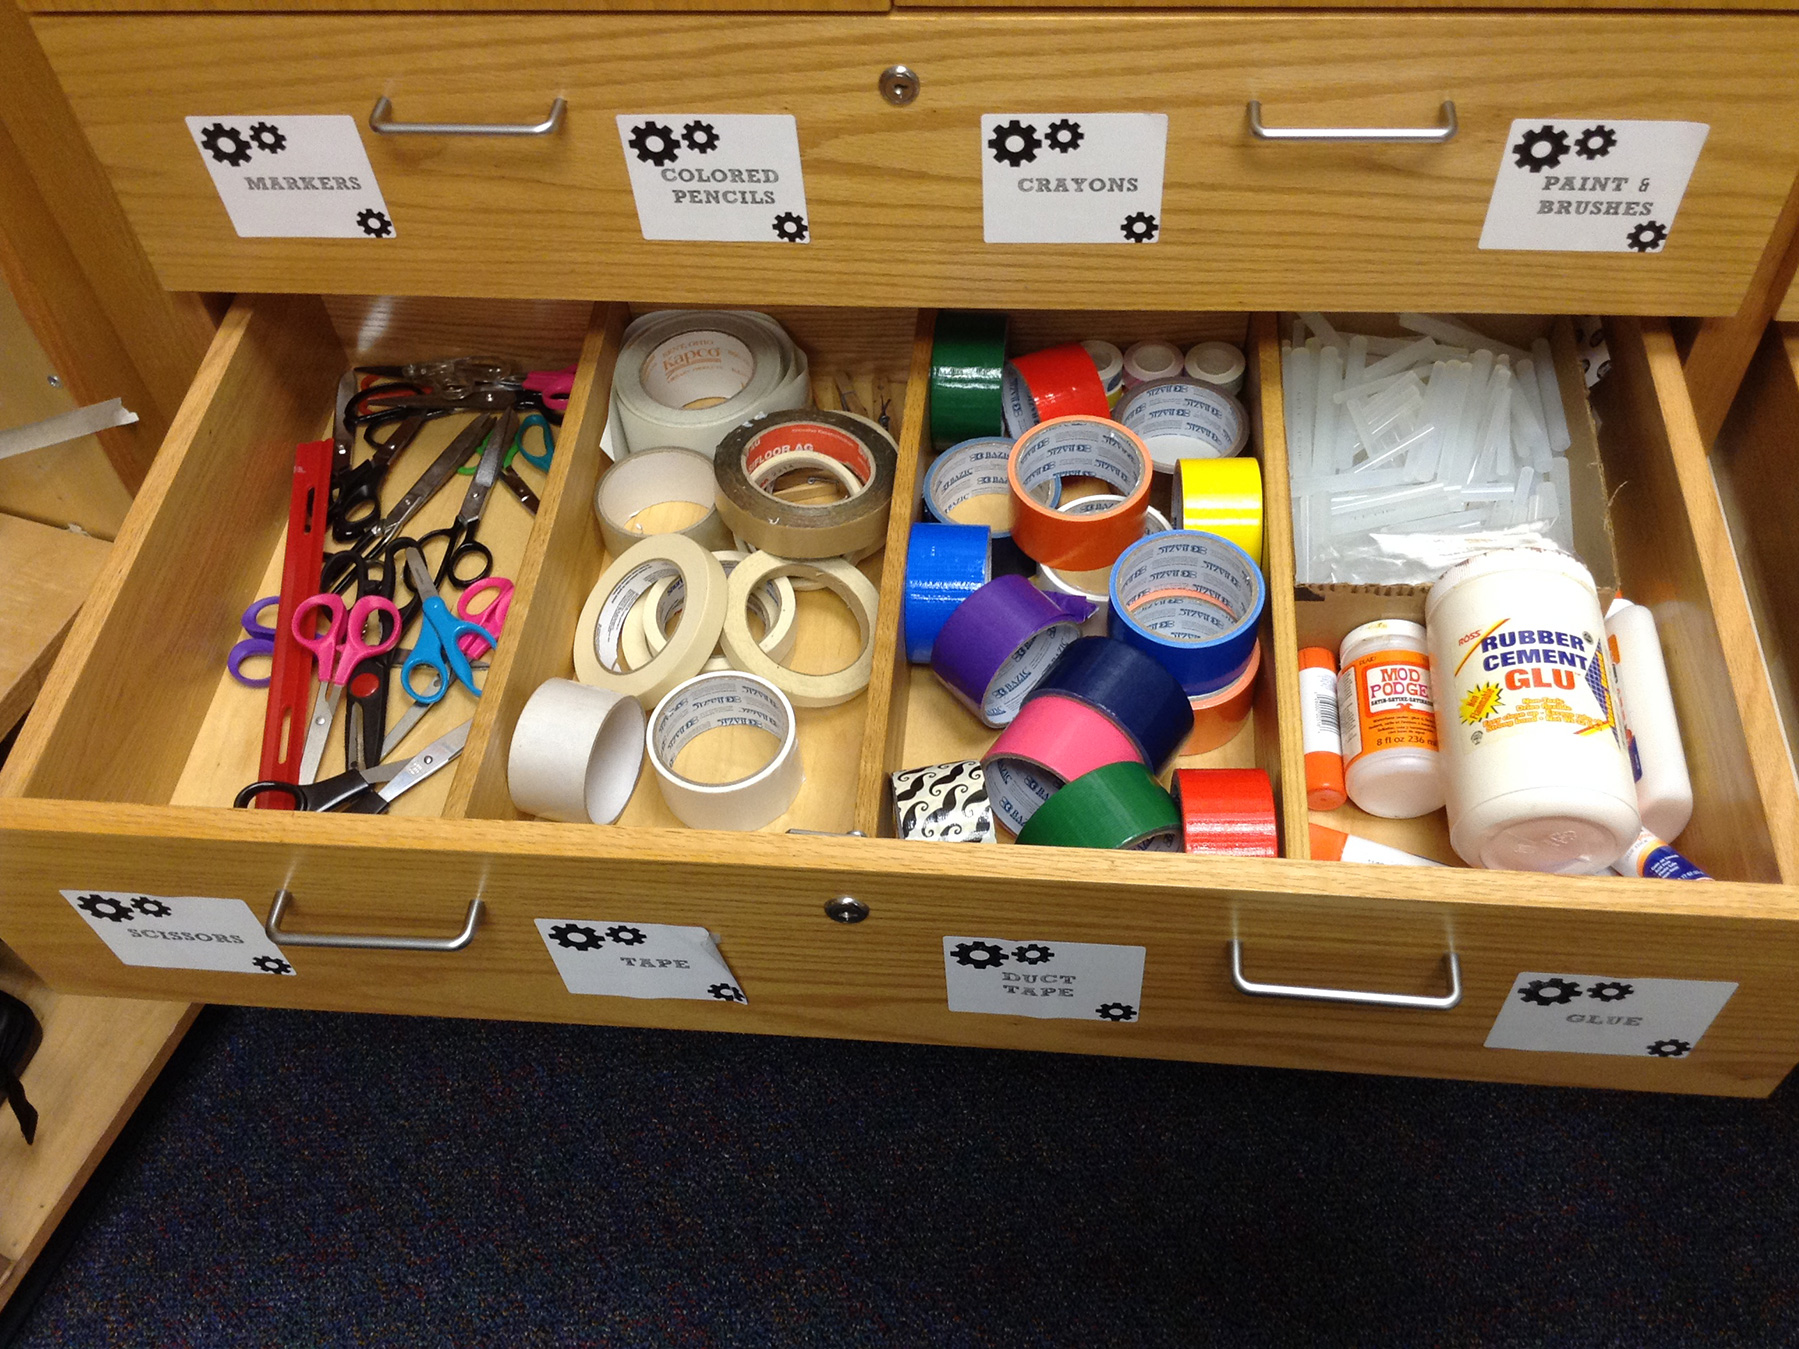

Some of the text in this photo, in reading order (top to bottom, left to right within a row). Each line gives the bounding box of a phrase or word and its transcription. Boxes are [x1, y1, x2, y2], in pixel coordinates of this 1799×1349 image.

[243, 175, 362, 191] MARKERS
[660, 168, 779, 184] COLORED
[1541, 175, 1651, 193] PAINT &
[1017, 177, 1139, 193] CRAYONS
[671, 189, 776, 205] PENCILS
[1536, 199, 1654, 217] BRUSHES
[662, 347, 721, 371] Kapco
[1480, 629, 1585, 653] RUBBER
[1482, 648, 1588, 673] CEMENT
[1005, 669, 1033, 693] BAZIC
[1379, 667, 1420, 683] MOD
[1504, 667, 1576, 691] GLU
[1369, 681, 1430, 698] PODGE
[1376, 738, 1383, 746] 8
[1408, 735, 1425, 744] 236
[126, 927, 245, 945] SCISSORS
[619, 956, 691, 970] TAPE
[1001, 971, 1077, 985] DUCT
[1002, 984, 1074, 998] TAPE
[1565, 1013, 1644, 1027] GLUE
